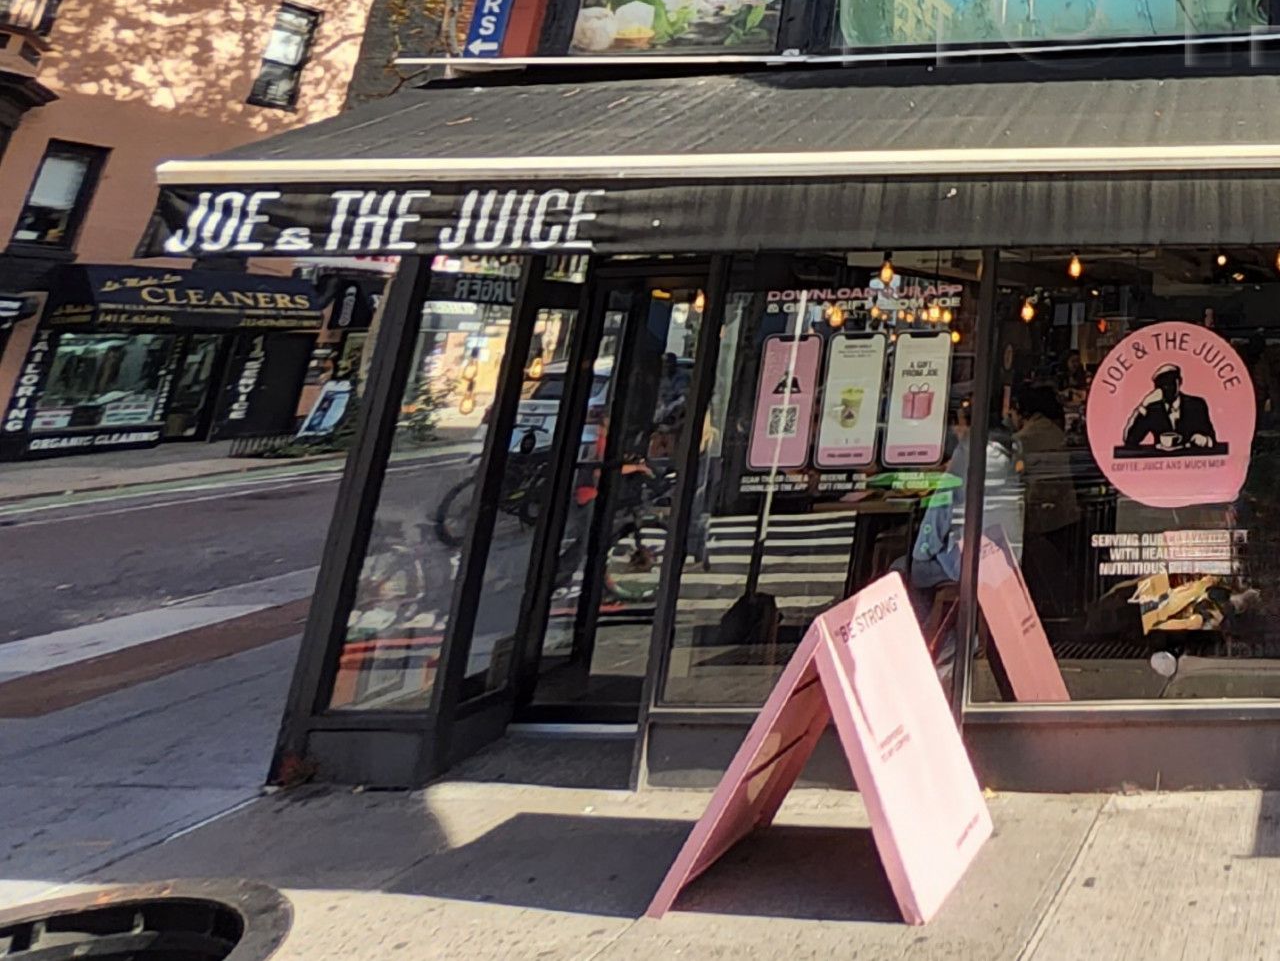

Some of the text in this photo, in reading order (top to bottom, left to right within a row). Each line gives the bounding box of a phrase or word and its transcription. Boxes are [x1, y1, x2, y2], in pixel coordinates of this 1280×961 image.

[164, 188, 605, 253] JOE & THE JUICE
[141, 287, 310, 310] CLEANERS
[5, 330, 53, 432] TAILORING
[1101, 331, 1242, 394] JOE & THE JUICE
[1110, 547, 1139, 561] WITH
